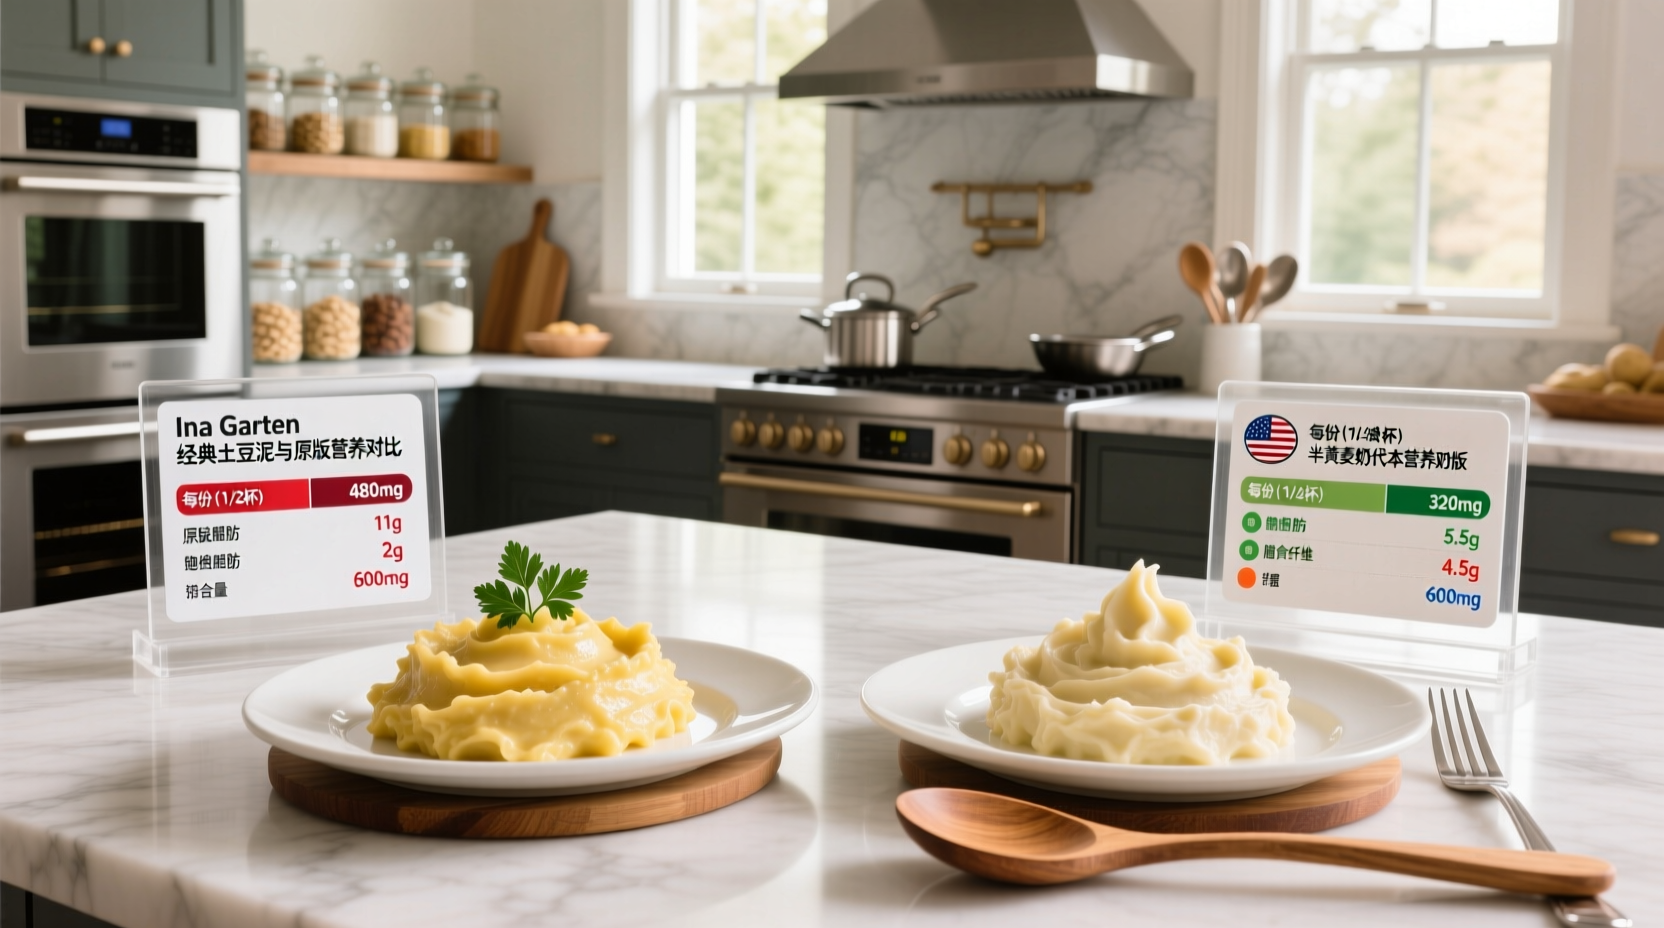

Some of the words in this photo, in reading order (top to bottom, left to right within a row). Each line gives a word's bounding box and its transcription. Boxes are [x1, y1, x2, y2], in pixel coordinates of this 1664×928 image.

[176, 416, 212, 437] Ina
[219, 415, 300, 436] Garten
[176, 436, 403, 465] 经典土豆泥与原版营养对比
[349, 482, 403, 500] 480mg
[1429, 494, 1482, 515] 320mg
[374, 515, 402, 533] 11g
[1444, 528, 1480, 550] 5.5g
[382, 541, 403, 562] 2g
[353, 571, 409, 588] 600mg
[1442, 558, 1480, 582] 4.5g
[1426, 586, 1481, 611] 600mg
